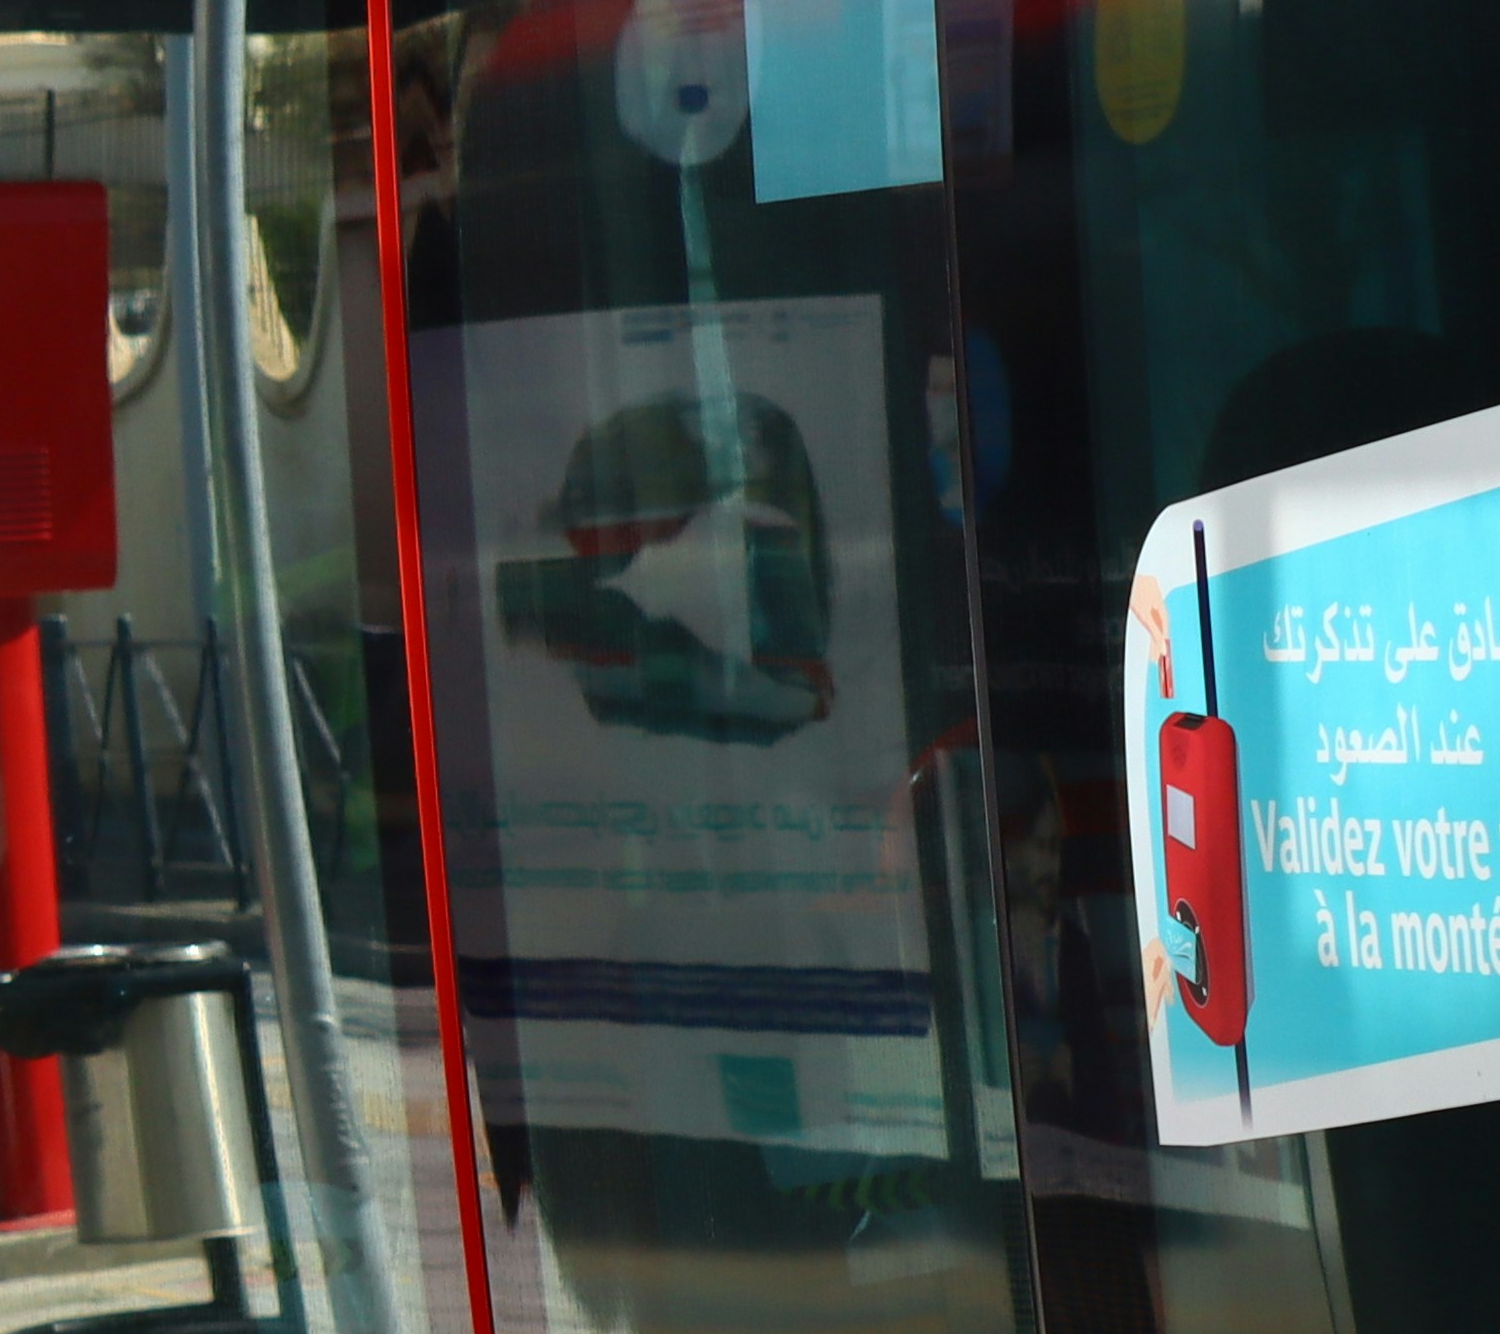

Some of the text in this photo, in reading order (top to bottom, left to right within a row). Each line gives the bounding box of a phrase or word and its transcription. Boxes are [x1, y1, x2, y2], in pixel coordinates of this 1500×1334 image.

[1262, 594, 1500, 685] ادق على تذكرتك
[1315, 701, 1485, 787] عند الصعود
[1250, 795, 1492, 882] Validez votre
[1313, 888, 1340, 968] à
[1345, 889, 1384, 970] la
